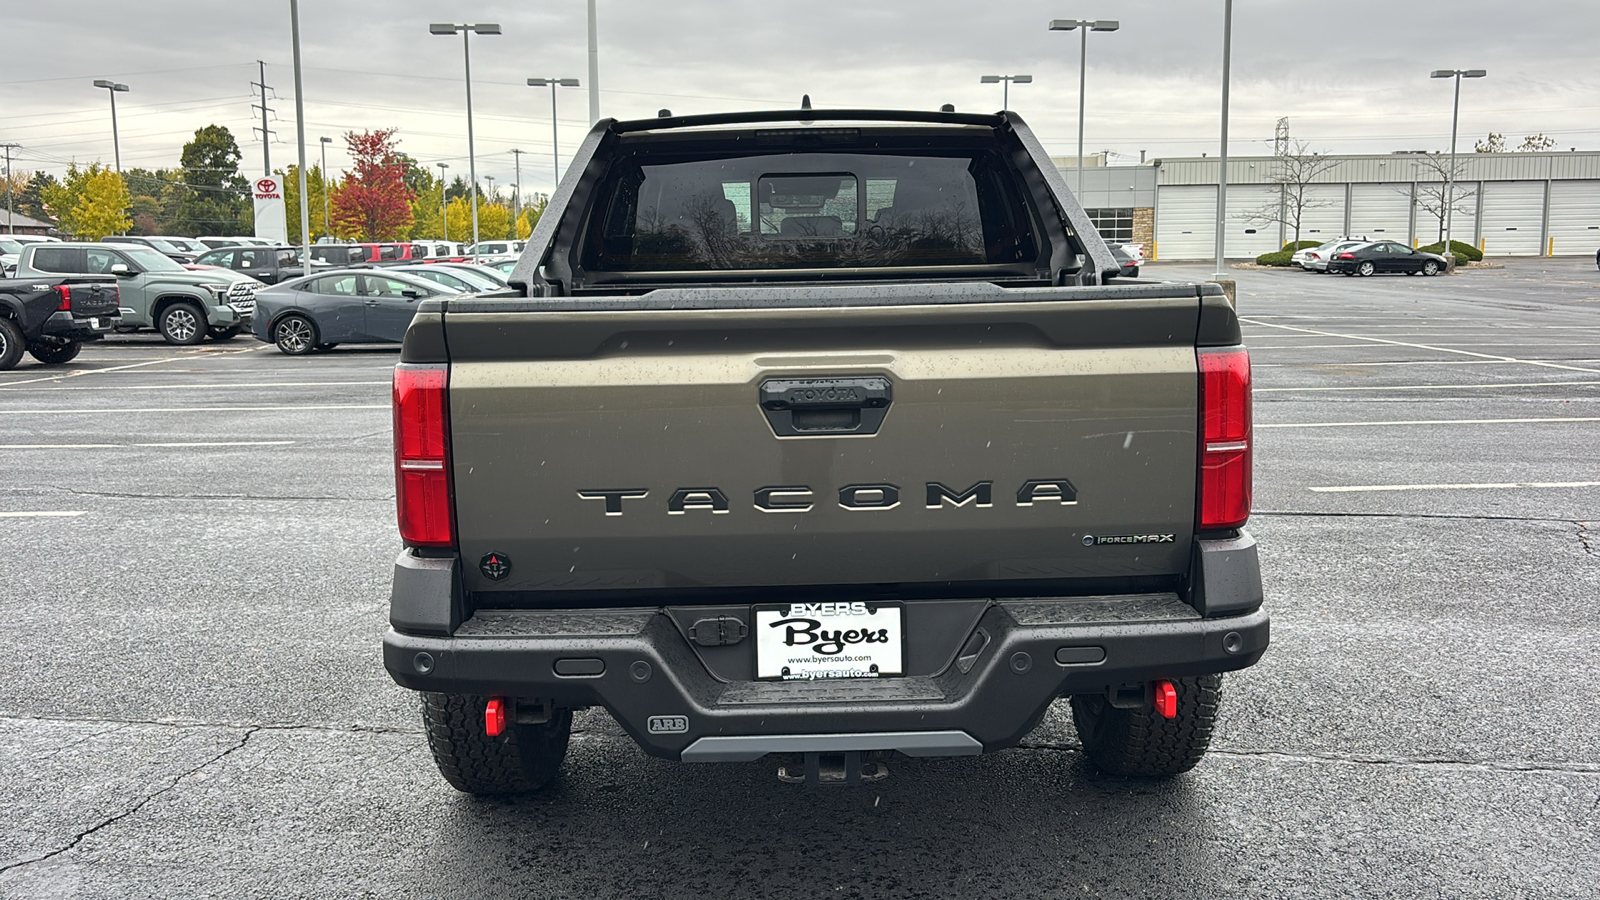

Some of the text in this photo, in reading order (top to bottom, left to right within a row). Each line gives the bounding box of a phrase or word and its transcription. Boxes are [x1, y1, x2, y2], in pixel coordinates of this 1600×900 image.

[794, 388, 858, 401] TOYOTA
[577, 478, 1078, 517] TACOMA
[790, 602, 866, 616] BYERS
[768, 617, 889, 656] Byers
[787, 655, 872, 665] www.byersauto.com
[782, 668, 879, 680] www.byersauto.com
[652, 718, 686, 731] ARB
